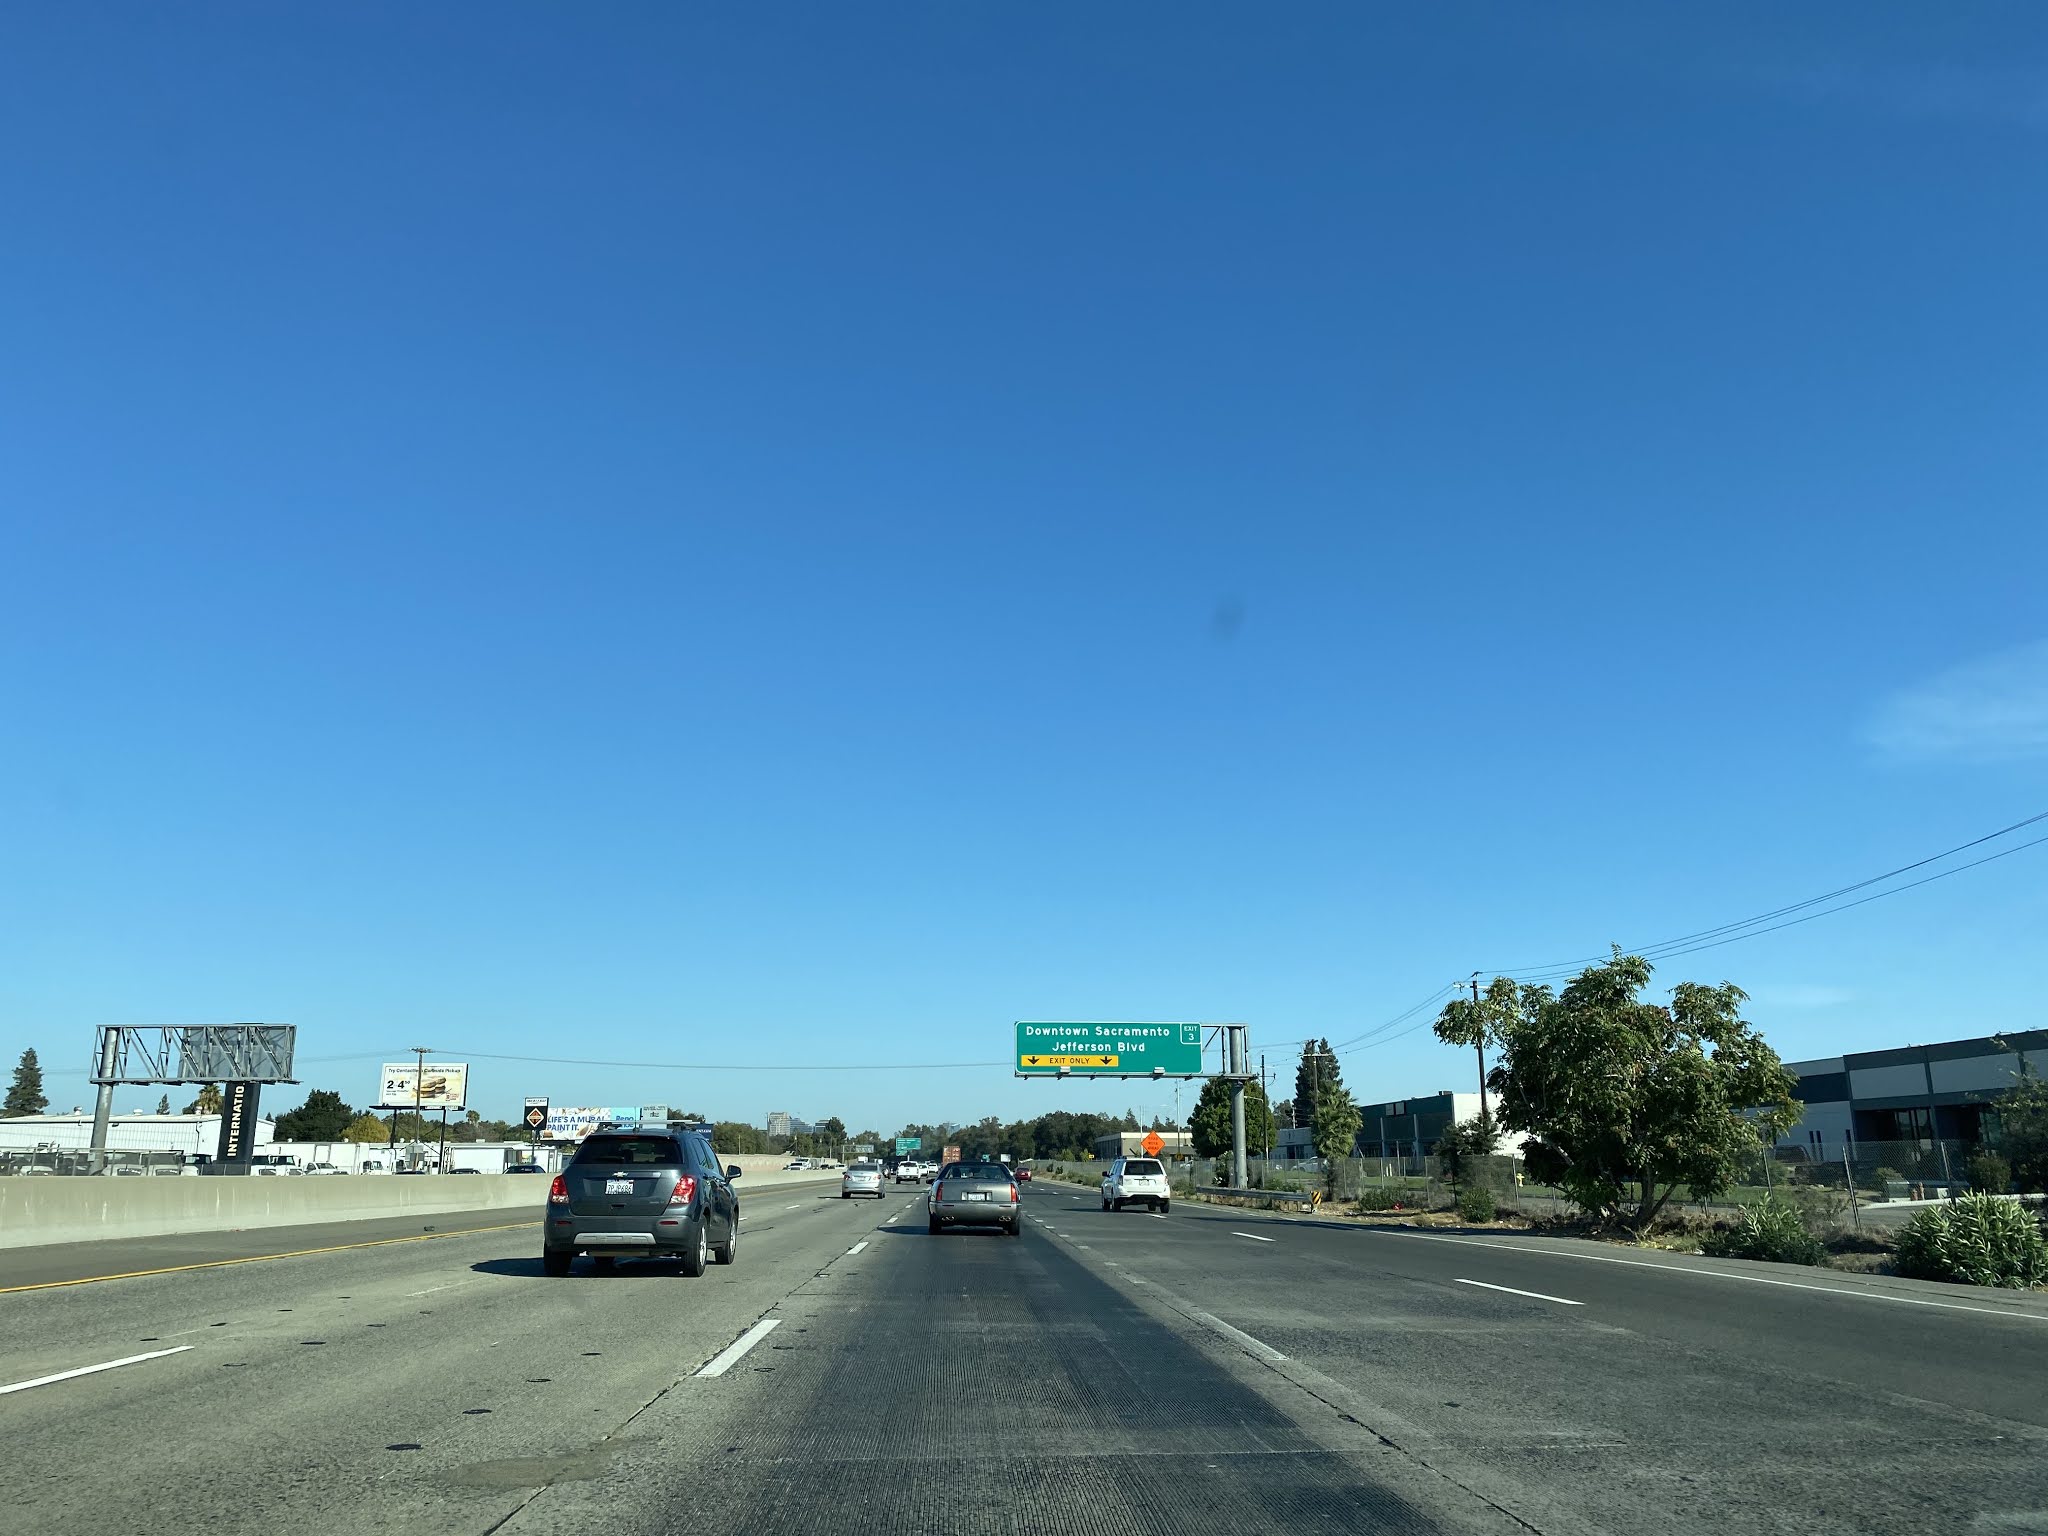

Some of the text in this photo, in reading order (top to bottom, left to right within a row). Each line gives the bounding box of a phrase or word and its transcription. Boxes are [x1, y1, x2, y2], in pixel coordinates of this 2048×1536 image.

[1026, 1026, 1170, 1036] Downtown Sacramento
[1188, 1033, 1195, 1041] 3
[1052, 1042, 1145, 1052] Jefferson Blvd
[386, 1080, 394, 1089] 2
[226, 1082, 246, 1157] INTERNATIO
